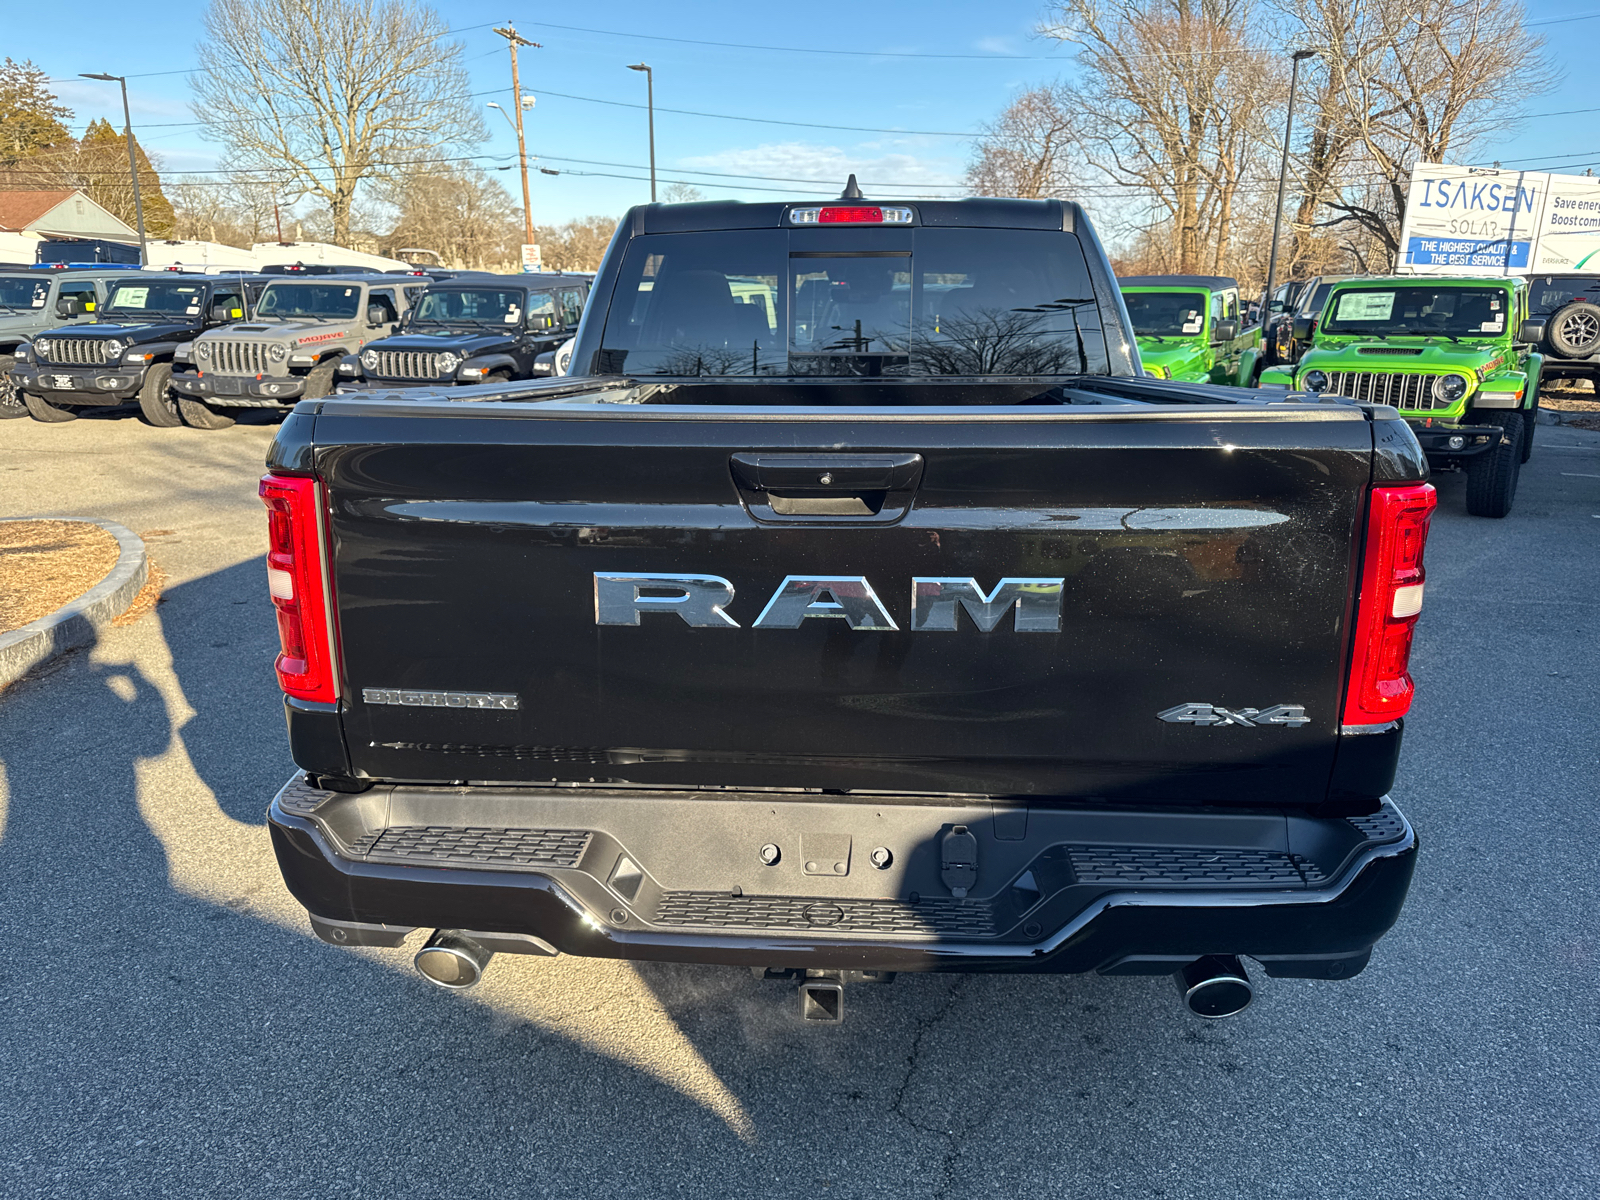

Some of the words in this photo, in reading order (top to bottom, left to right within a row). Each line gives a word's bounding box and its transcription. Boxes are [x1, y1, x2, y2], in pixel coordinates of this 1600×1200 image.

[1419, 178, 1536, 213] ISAKSEN
[1553, 196, 1577, 210] Save
[1577, 200, 1600, 214] ener
[1550, 213, 1578, 227] Boost
[1449, 219, 1498, 239] SOLAR
[1420, 240, 1437, 252] THE
[1439, 242, 1475, 254] HIGHEST
[1476, 243, 1511, 255] QUALITY
[1511, 245, 1518, 255] &
[1430, 253, 1447, 264] THE
[1448, 254, 1470, 265] BEST
[1471, 256, 1506, 267] SERVICE
[298, 332, 345, 344] MOJAVE
[1481, 356, 1505, 373] MOJAVE
[593, 571, 1066, 633] RAM
